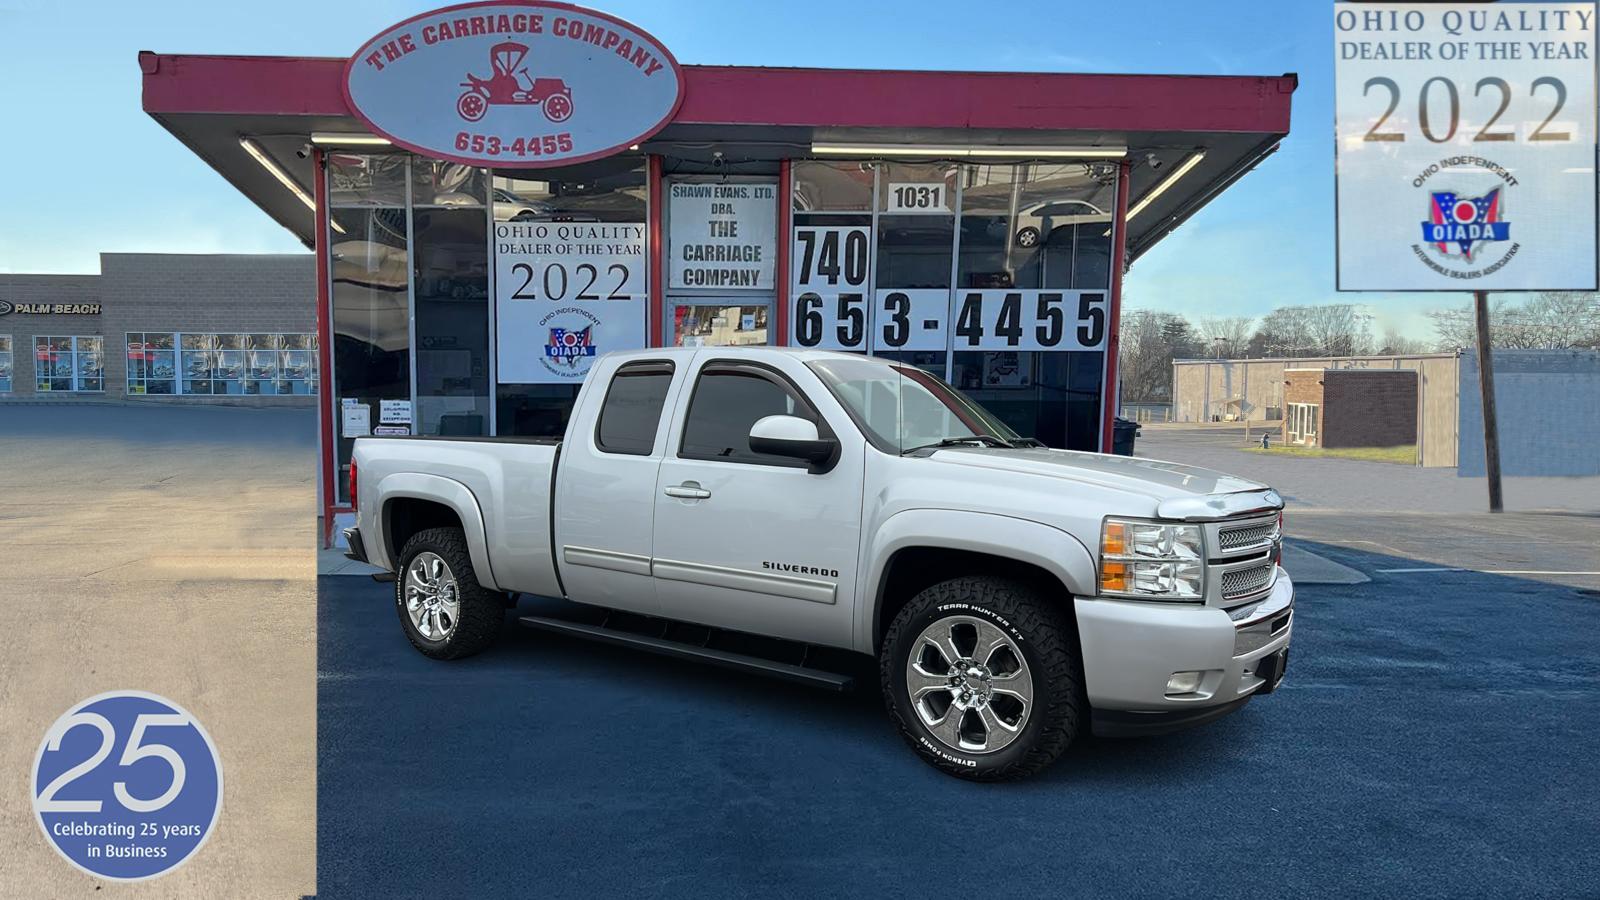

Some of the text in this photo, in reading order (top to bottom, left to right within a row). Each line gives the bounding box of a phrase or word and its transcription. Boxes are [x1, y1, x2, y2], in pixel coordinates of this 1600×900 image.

[1336, 10, 1593, 35] OHIO QUALITY
[366, 14, 664, 77] THE CARRIAGE COMPANY
[1340, 42, 1589, 60] DEALER OF THE YEAR
[1362, 76, 1571, 143] 2022
[455, 132, 573, 156] 653-4455
[1412, 155, 1519, 188] OHIO INDEPENDENT
[673, 186, 712, 198] SHAWN
[754, 187, 775, 199] LTD.
[894, 186, 940, 208] 1031
[711, 203, 736, 215] DBA.
[497, 226, 644, 240] OHIO QUALITY
[708, 220, 737, 237] THE
[1432, 224, 1495, 240] OIADA
[500, 243, 641, 255] DEALER OF THE YEAR
[683, 244, 762, 262] CARRIAGE
[797, 230, 868, 286] 740
[511, 263, 631, 301] 2022
[683, 268, 761, 286] COMPANY
[15, 303, 100, 314] PALM BEACH
[539, 307, 601, 326] OHIO INDEPENDENT
[551, 346, 588, 356] OIADA
[762, 561, 839, 578] SILVERADO
[971, 605, 1010, 627] HUNTER
